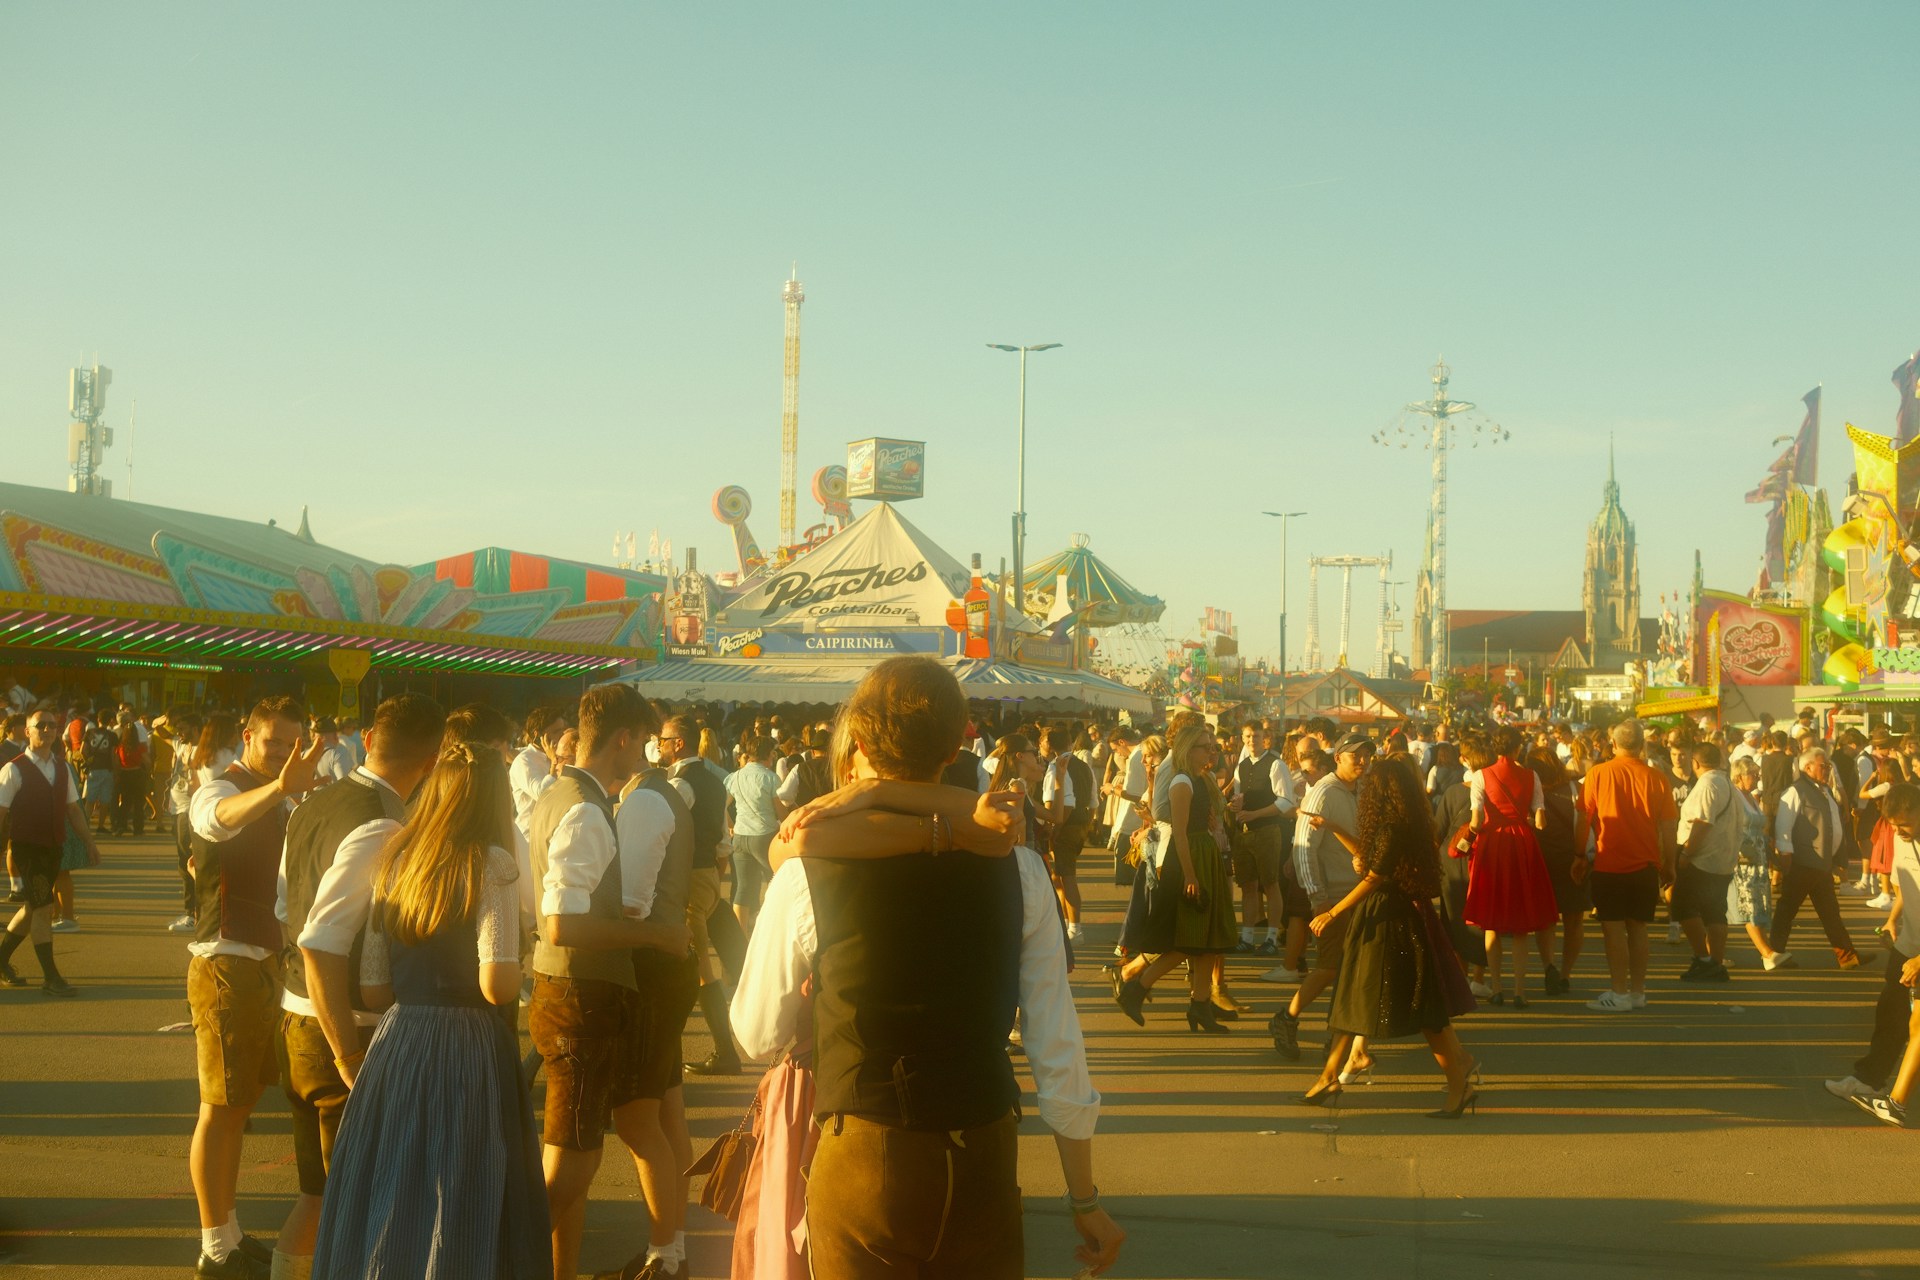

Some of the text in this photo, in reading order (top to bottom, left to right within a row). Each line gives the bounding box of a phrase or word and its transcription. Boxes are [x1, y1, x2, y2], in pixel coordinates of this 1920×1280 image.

[879, 445, 923, 471] Peaches
[760, 561, 927, 617] Peaches
[808, 604, 912, 615] Cocktailbar
[966, 602, 988, 614] APEROL
[718, 628, 763, 656] Peaches
[806, 637, 895, 649] CAIPIRINHA
[671, 647, 706, 656] Wiesn Mule
